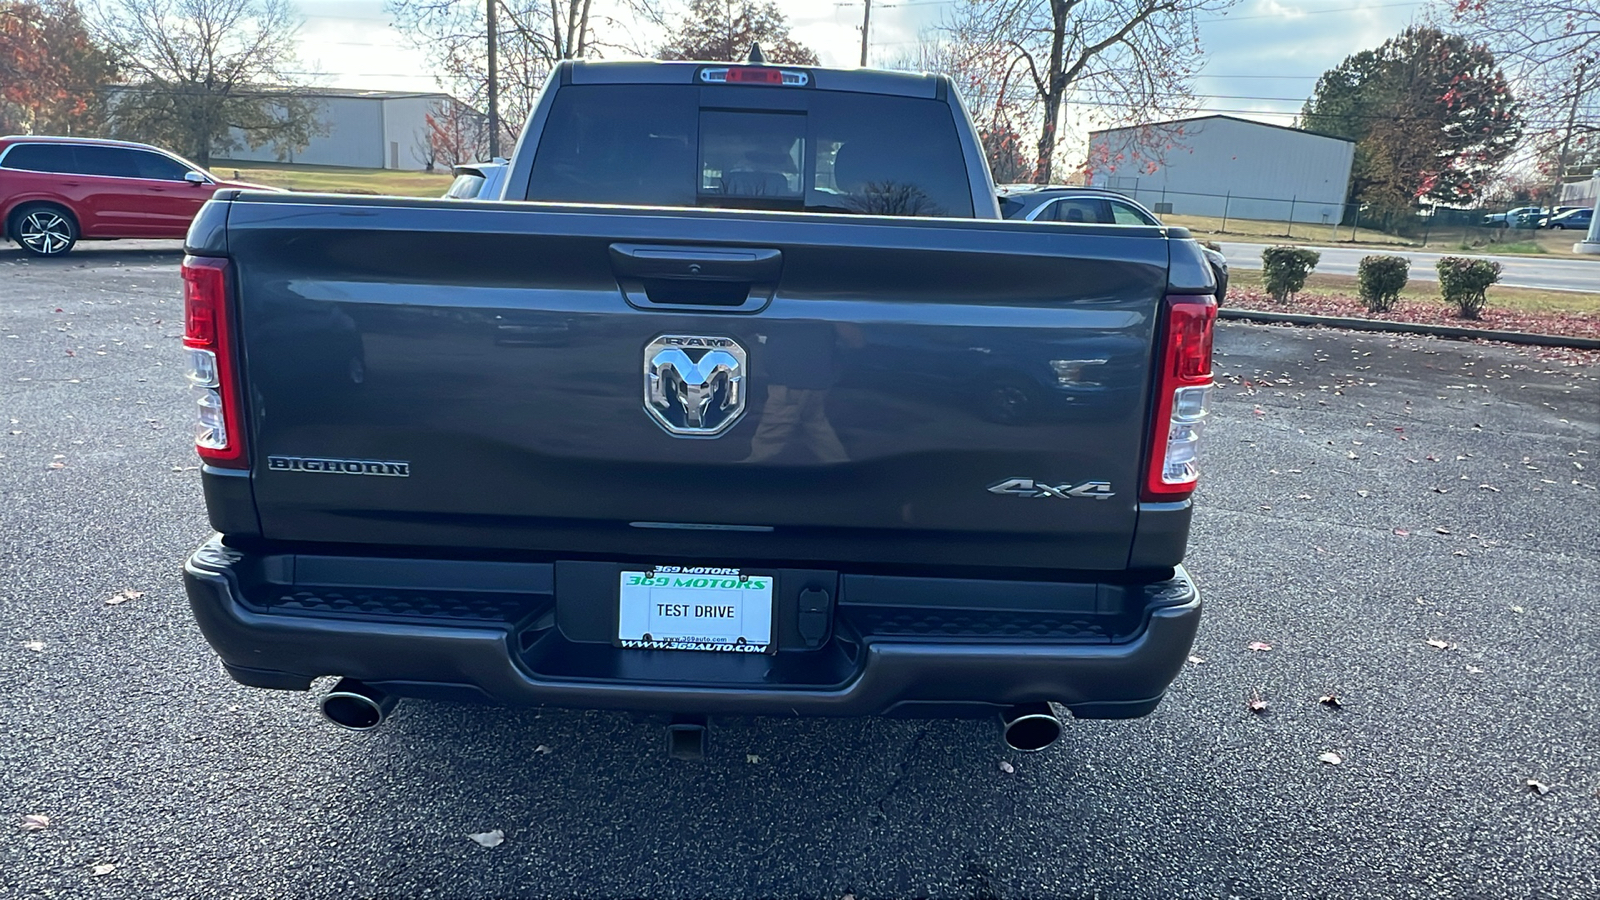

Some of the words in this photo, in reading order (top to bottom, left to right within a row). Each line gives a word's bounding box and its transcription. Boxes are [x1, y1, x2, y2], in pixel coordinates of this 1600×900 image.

[666, 337, 726, 347] RAM
[267, 455, 410, 477] BIGHORN
[653, 565, 682, 574] 369
[682, 566, 740, 575] MOTORS
[626, 576, 670, 587] 369
[673, 577, 768, 590] MOTORS
[657, 603, 690, 617] TEST
[694, 605, 735, 618] DRIVE
[621, 640, 767, 653] WWW.369AUTO.COM
